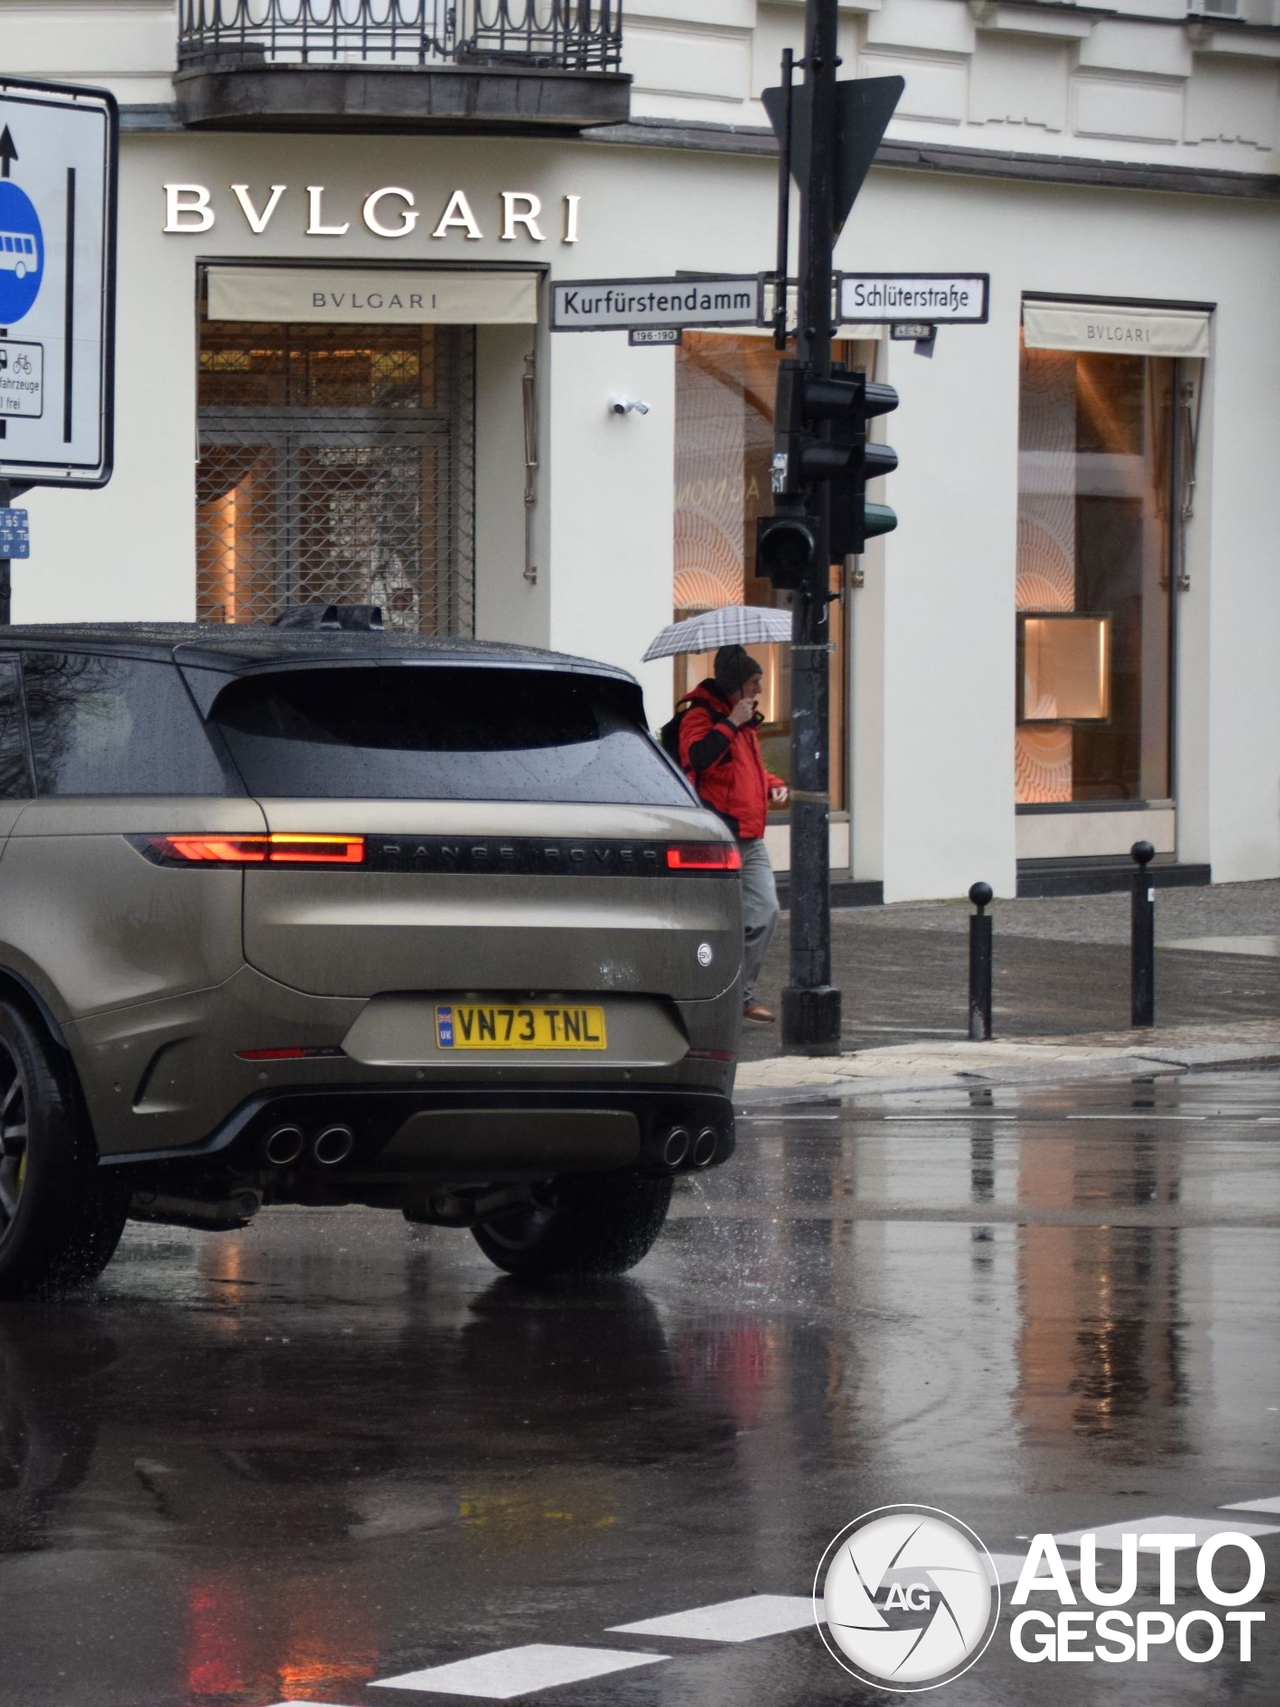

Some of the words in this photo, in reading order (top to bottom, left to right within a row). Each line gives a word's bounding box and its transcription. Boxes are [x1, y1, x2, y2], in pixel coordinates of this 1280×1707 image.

[163, 184, 581, 243] BVLGARI
[312, 292, 438, 309] BVLGARI
[564, 288, 750, 314] Kurfürstendamm
[855, 284, 968, 311] Schlüterstraße
[637, 331, 674, 340] 196-190
[1087, 325, 1150, 342] BVLGARI
[6, 397, 20, 410] frei
[383, 846, 514, 860] RANGE
[544, 848, 658, 863] ROVER
[457, 1009, 536, 1041] VN73
[544, 1010, 599, 1041] TNL
[440, 1030, 452, 1040] UK
